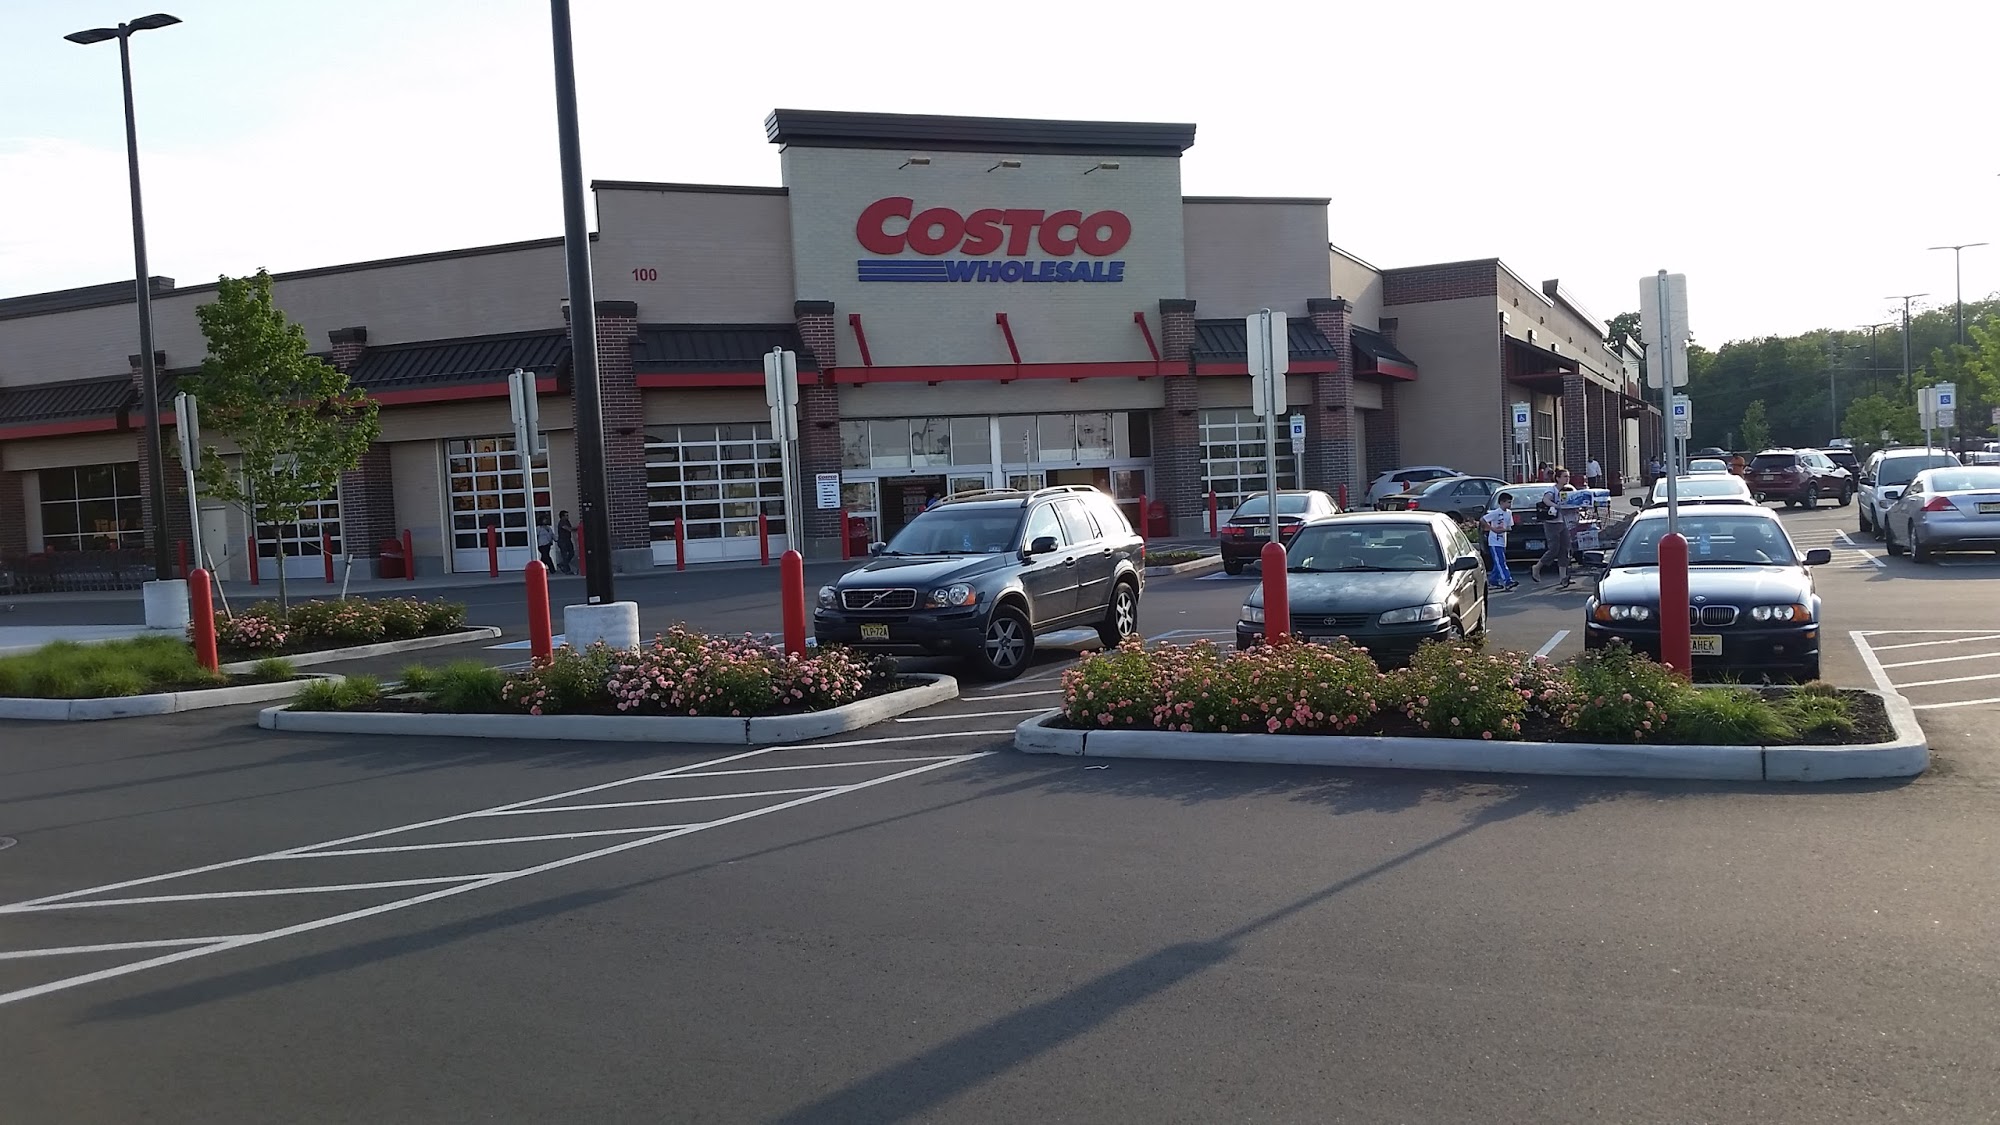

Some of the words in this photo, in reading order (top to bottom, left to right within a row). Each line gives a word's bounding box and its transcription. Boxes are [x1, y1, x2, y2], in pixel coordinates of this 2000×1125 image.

[856, 196, 1132, 256] COSTCO
[631, 268, 657, 281] 100
[945, 260, 1126, 283] WHOLESALE
